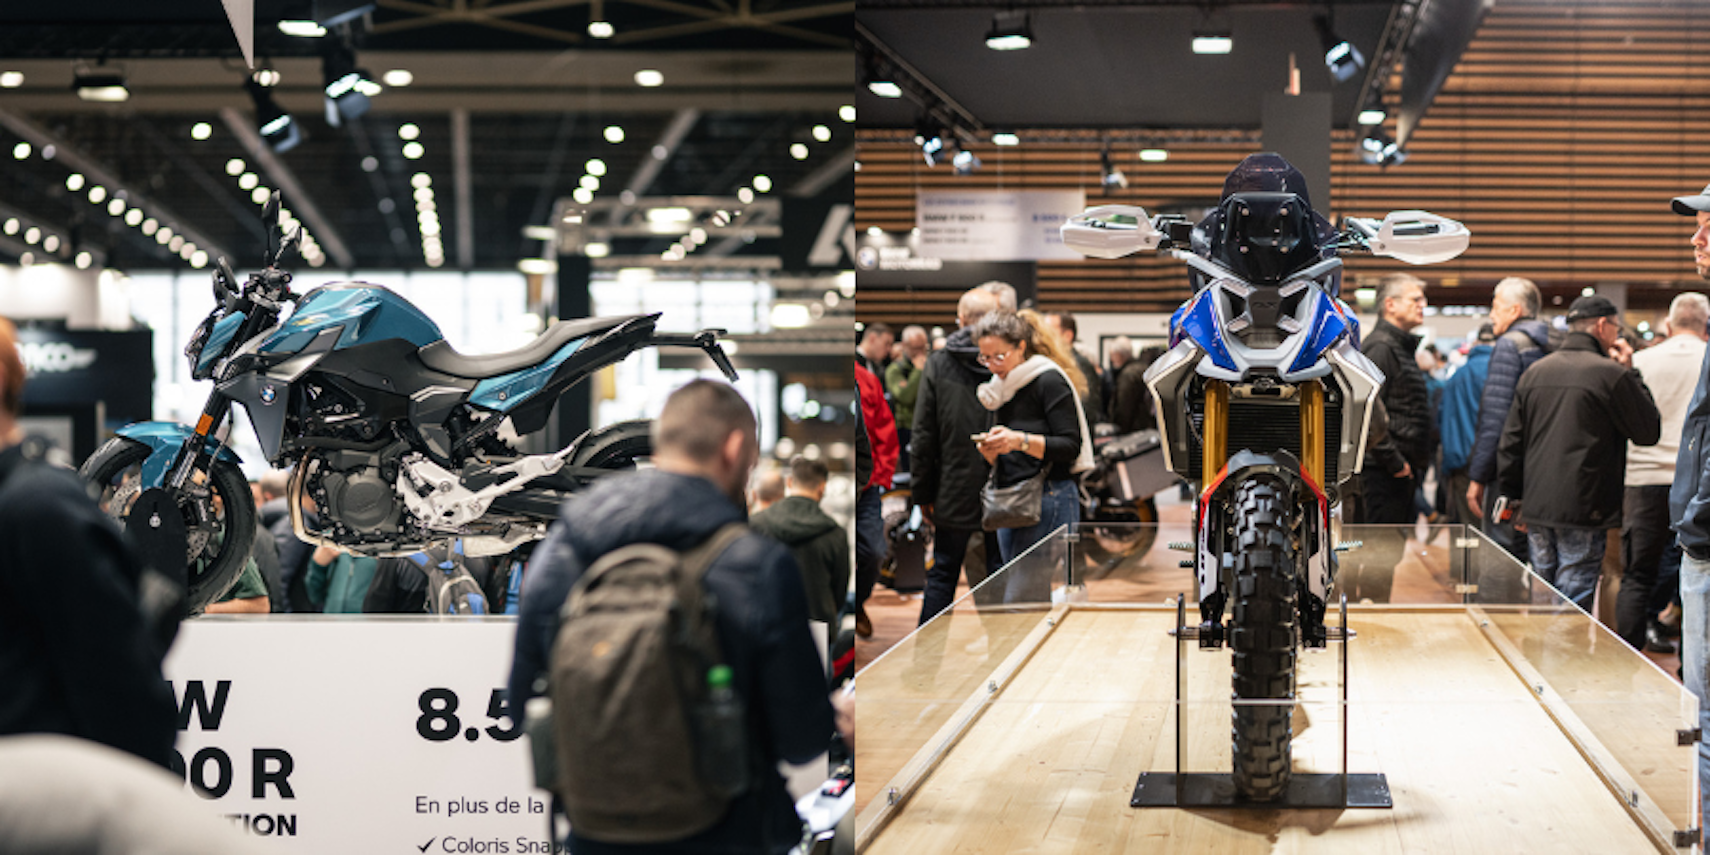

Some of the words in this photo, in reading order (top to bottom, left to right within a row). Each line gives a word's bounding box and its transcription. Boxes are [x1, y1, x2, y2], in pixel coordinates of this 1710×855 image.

[164, 679, 232, 731] W
[251, 748, 296, 798] R
[415, 796, 440, 813] En
[447, 796, 489, 817] plus
[495, 796, 520, 814] de
[528, 796, 544, 814] la
[441, 837, 510, 854] Coloris
